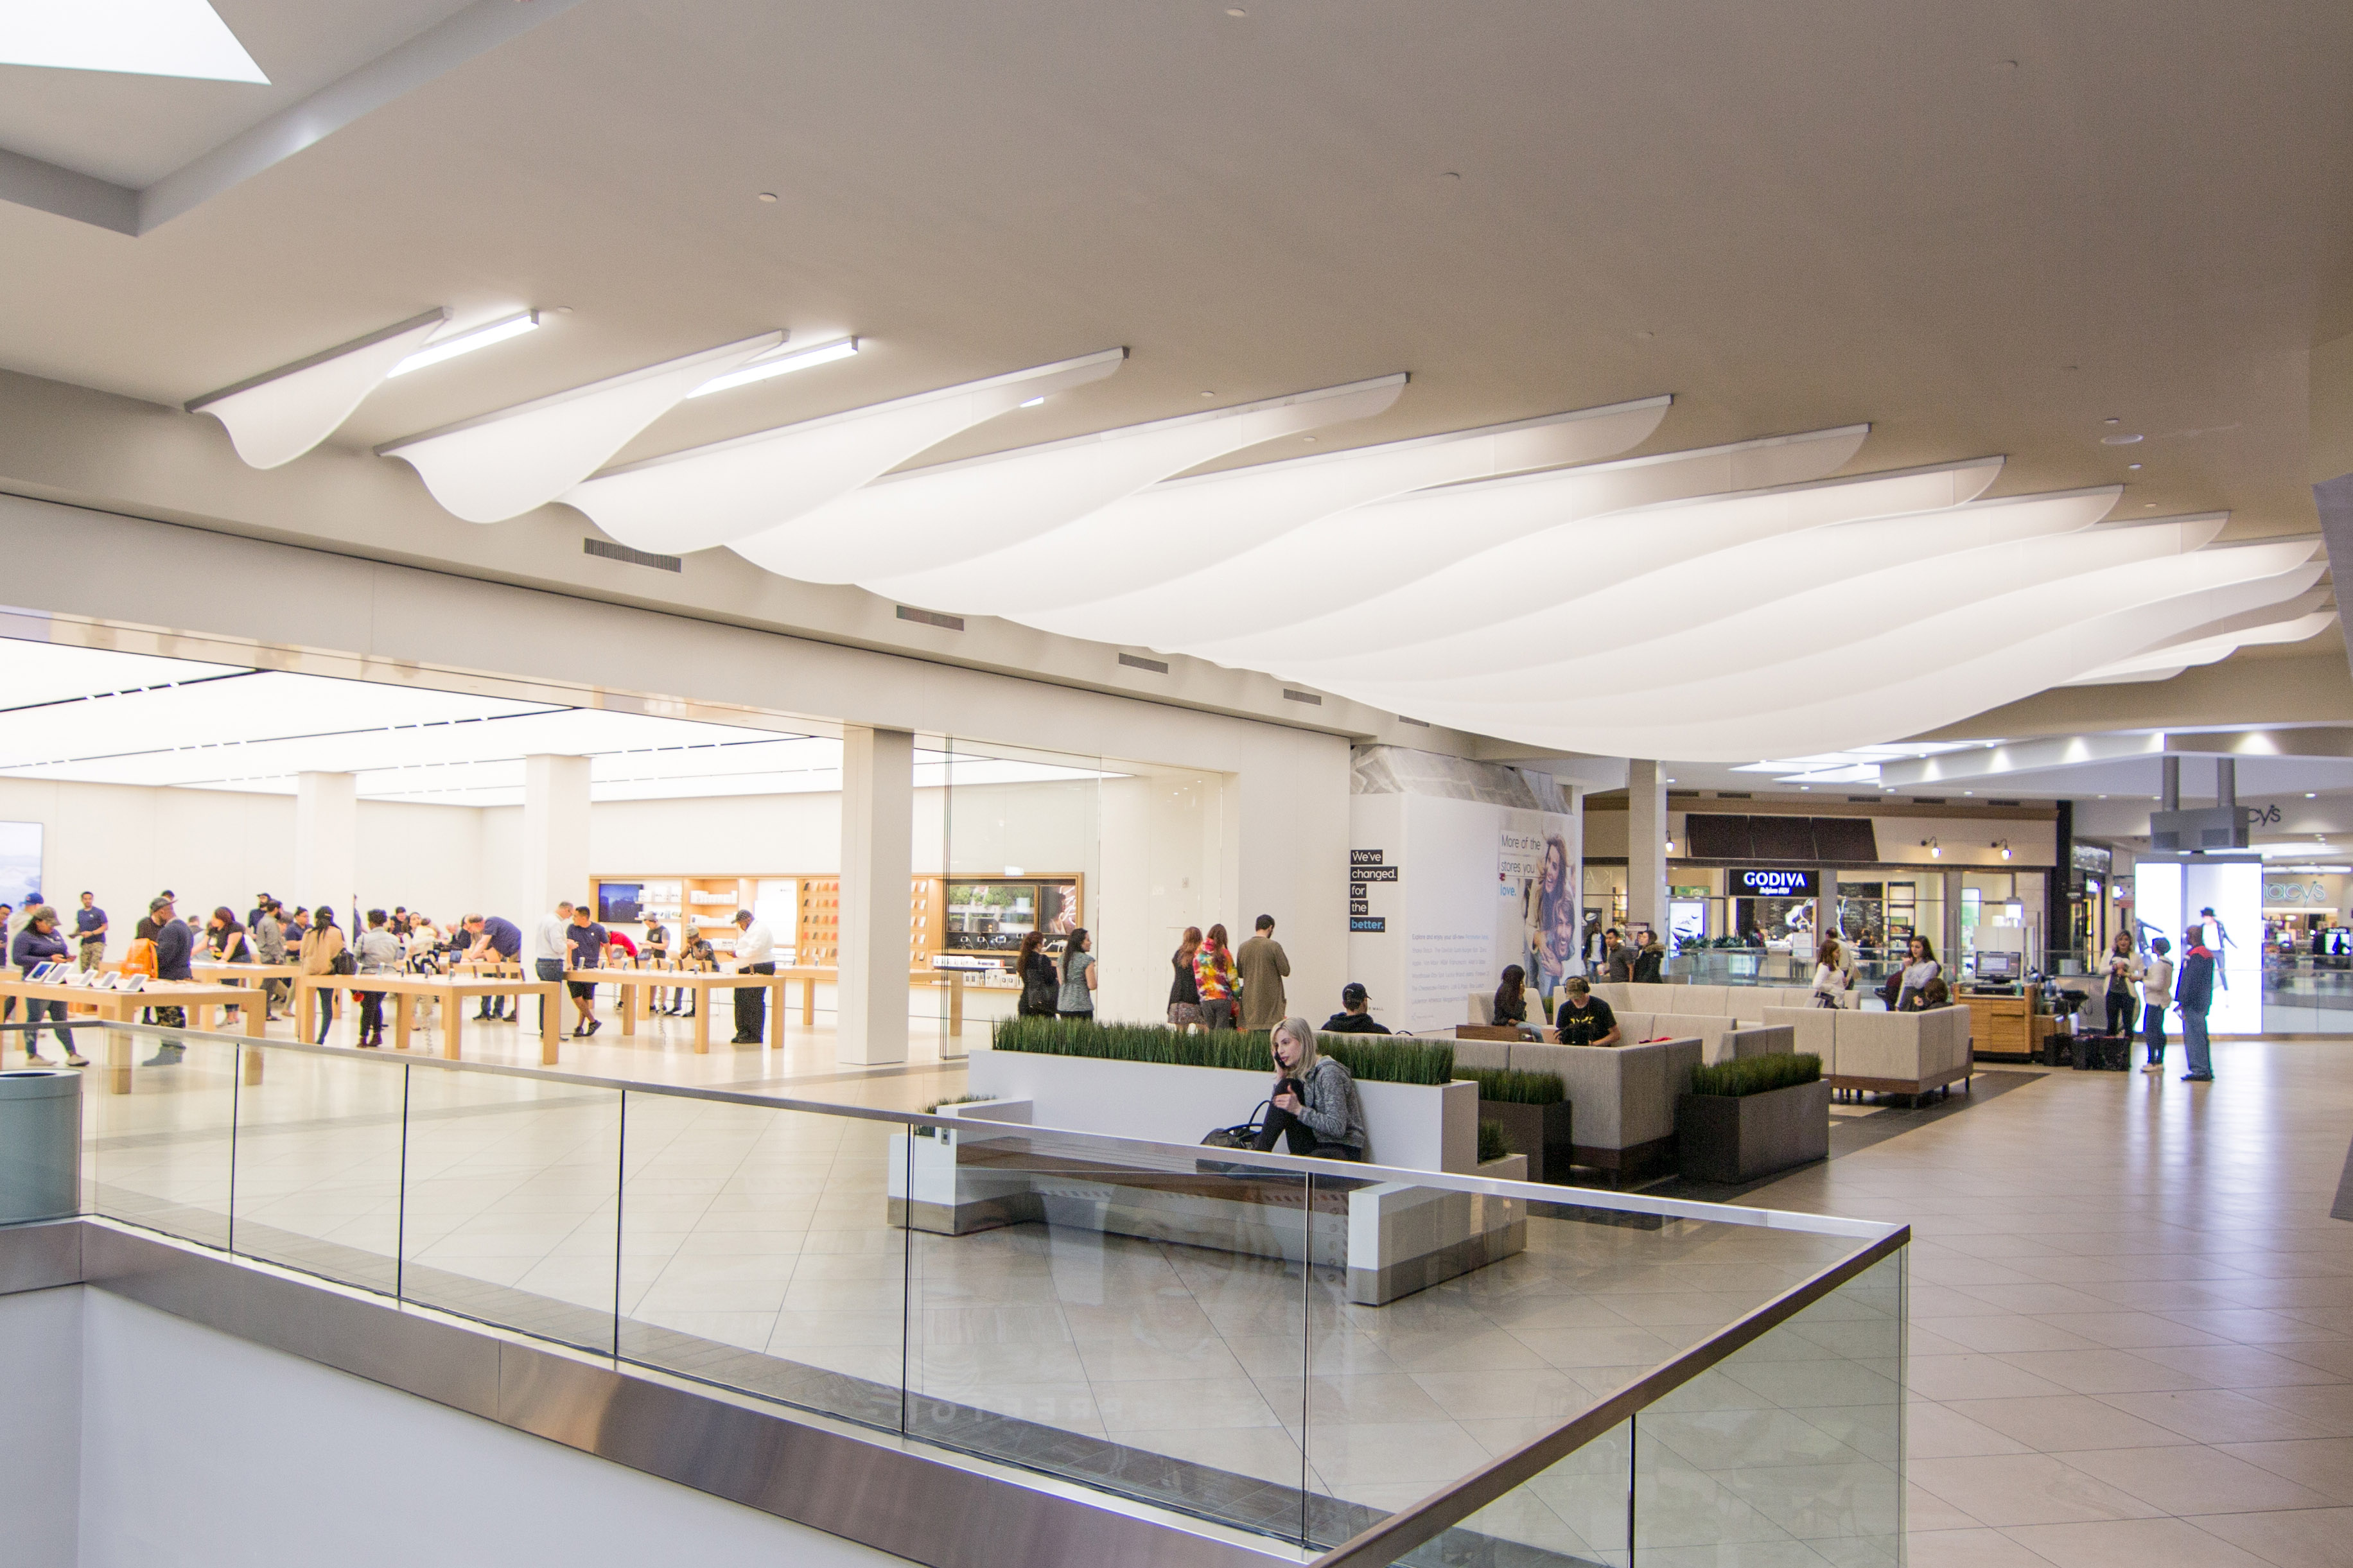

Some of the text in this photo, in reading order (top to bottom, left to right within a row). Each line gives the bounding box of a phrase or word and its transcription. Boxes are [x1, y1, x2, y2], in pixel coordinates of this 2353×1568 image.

[2249, 805, 2281, 826] cy's
[1501, 834, 1541, 850] More of the
[1352, 851, 1382, 862] We've
[1501, 861, 1535, 876] stores you
[1351, 869, 1397, 881] changed.
[1743, 871, 1806, 887] GODIVA
[1351, 885, 1365, 896] for
[1500, 883, 1516, 896] love.
[1351, 902, 1367, 912] the
[1351, 919, 1385, 930] better.
